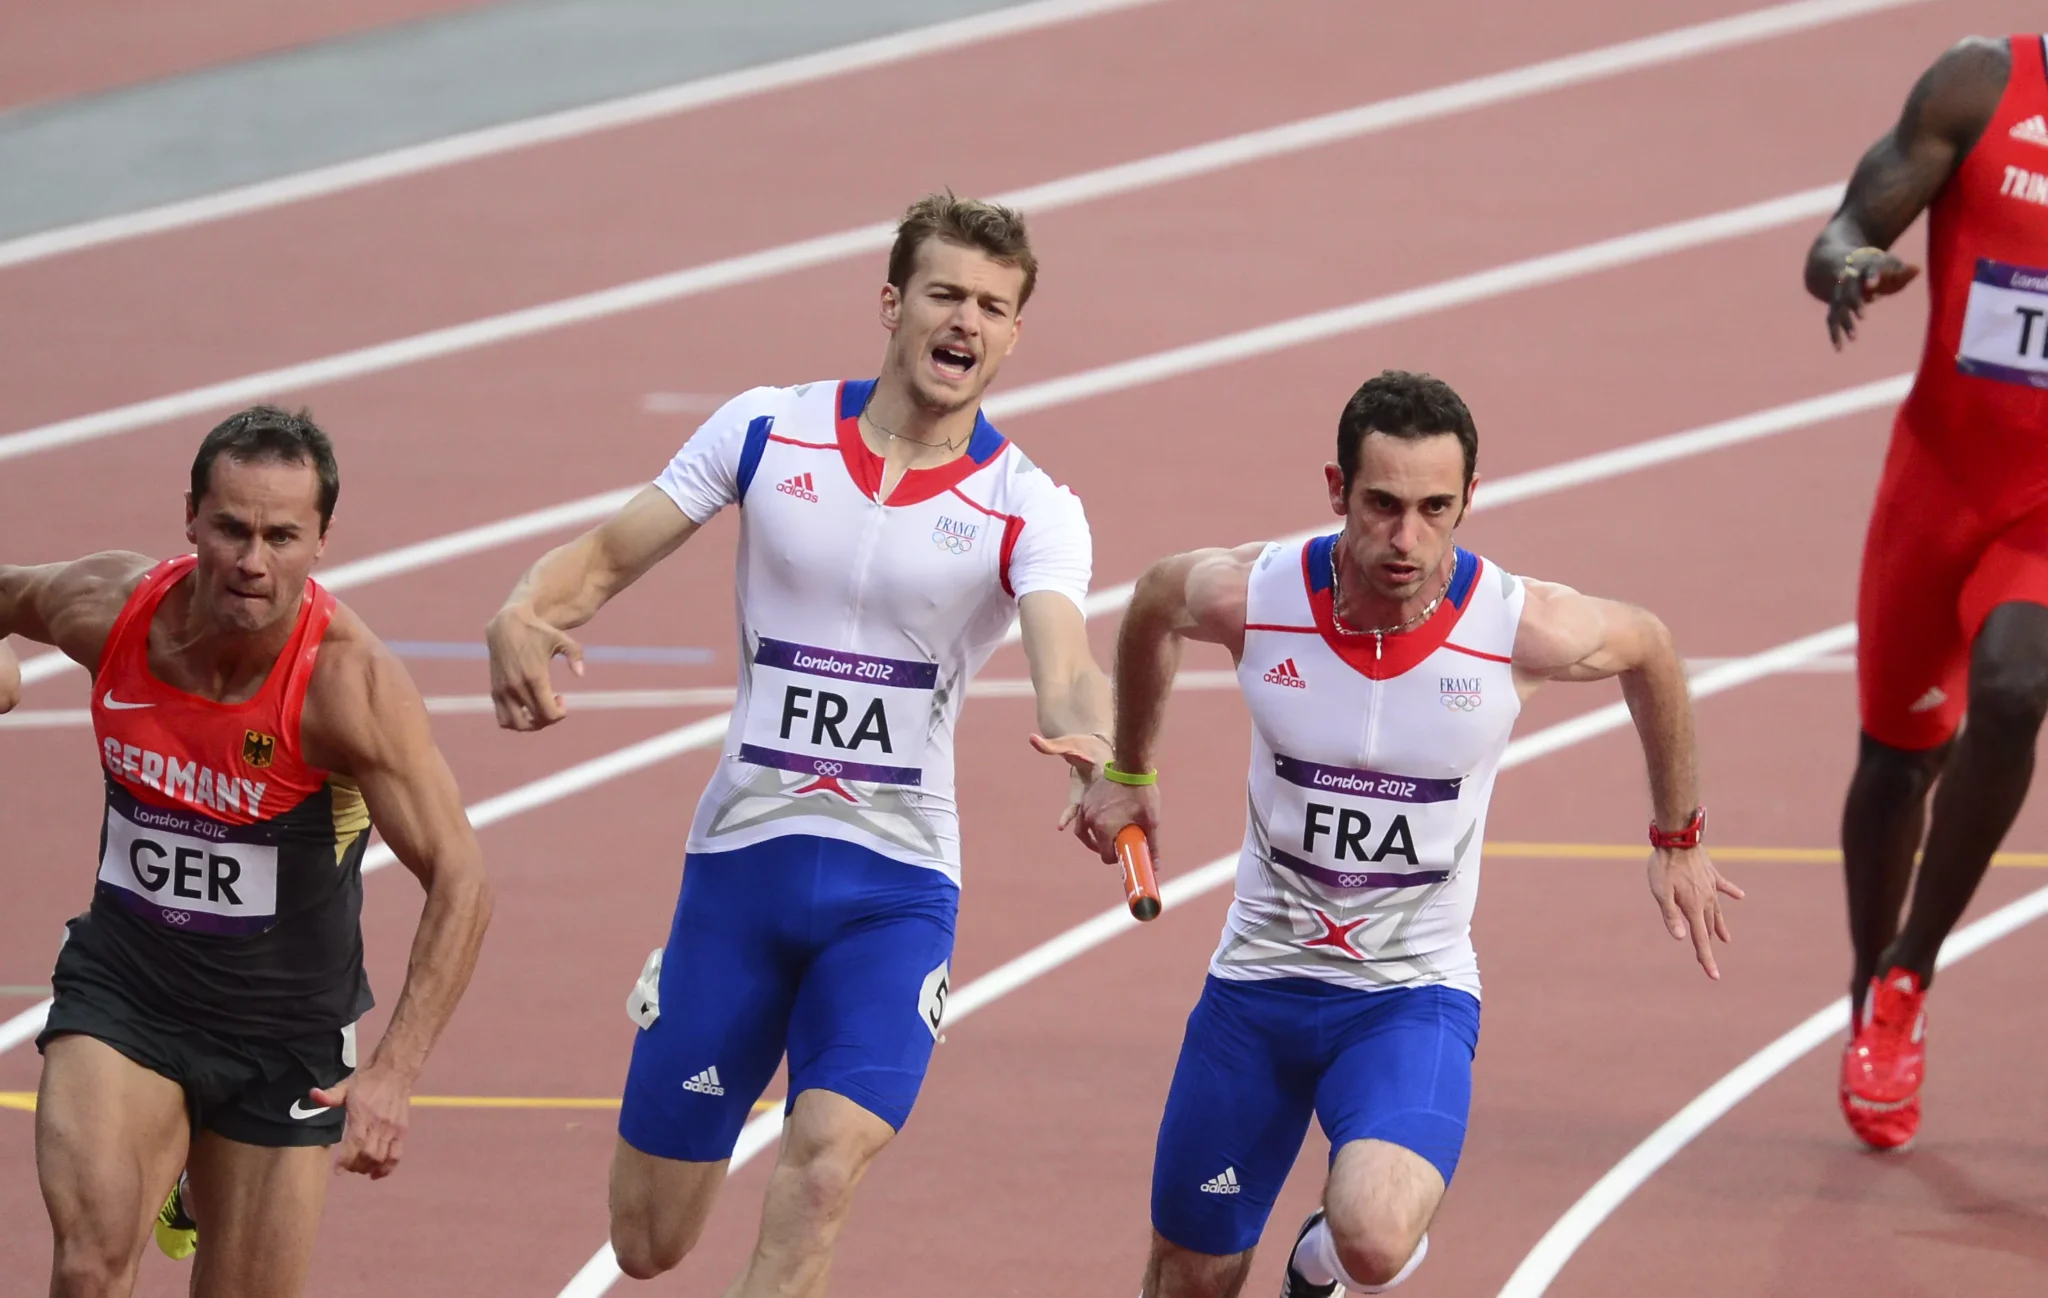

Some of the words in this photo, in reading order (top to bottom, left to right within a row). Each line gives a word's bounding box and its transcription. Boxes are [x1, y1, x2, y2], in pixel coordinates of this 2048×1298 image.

[2016, 306, 2048, 359] T
[776, 482, 818, 503] adidas
[936, 516, 979, 539] FRANCE
[793, 650, 853, 675] London
[855, 660, 894, 681] 2012
[1263, 673, 1306, 689] adidas
[1440, 677, 1481, 692] FRANCE
[779, 685, 893, 754] FRA
[104, 737, 266, 817] GERMANY
[1313, 769, 1375, 793] London
[1377, 779, 1417, 798] 2012
[134, 806, 190, 830] London
[193, 819, 229, 839] 2012
[1303, 802, 1420, 865] FRA
[129, 838, 244, 906] GER
[929, 977, 948, 1030] 5
[682, 1080, 724, 1096] adidas
[1200, 1183, 1241, 1194] adidas
